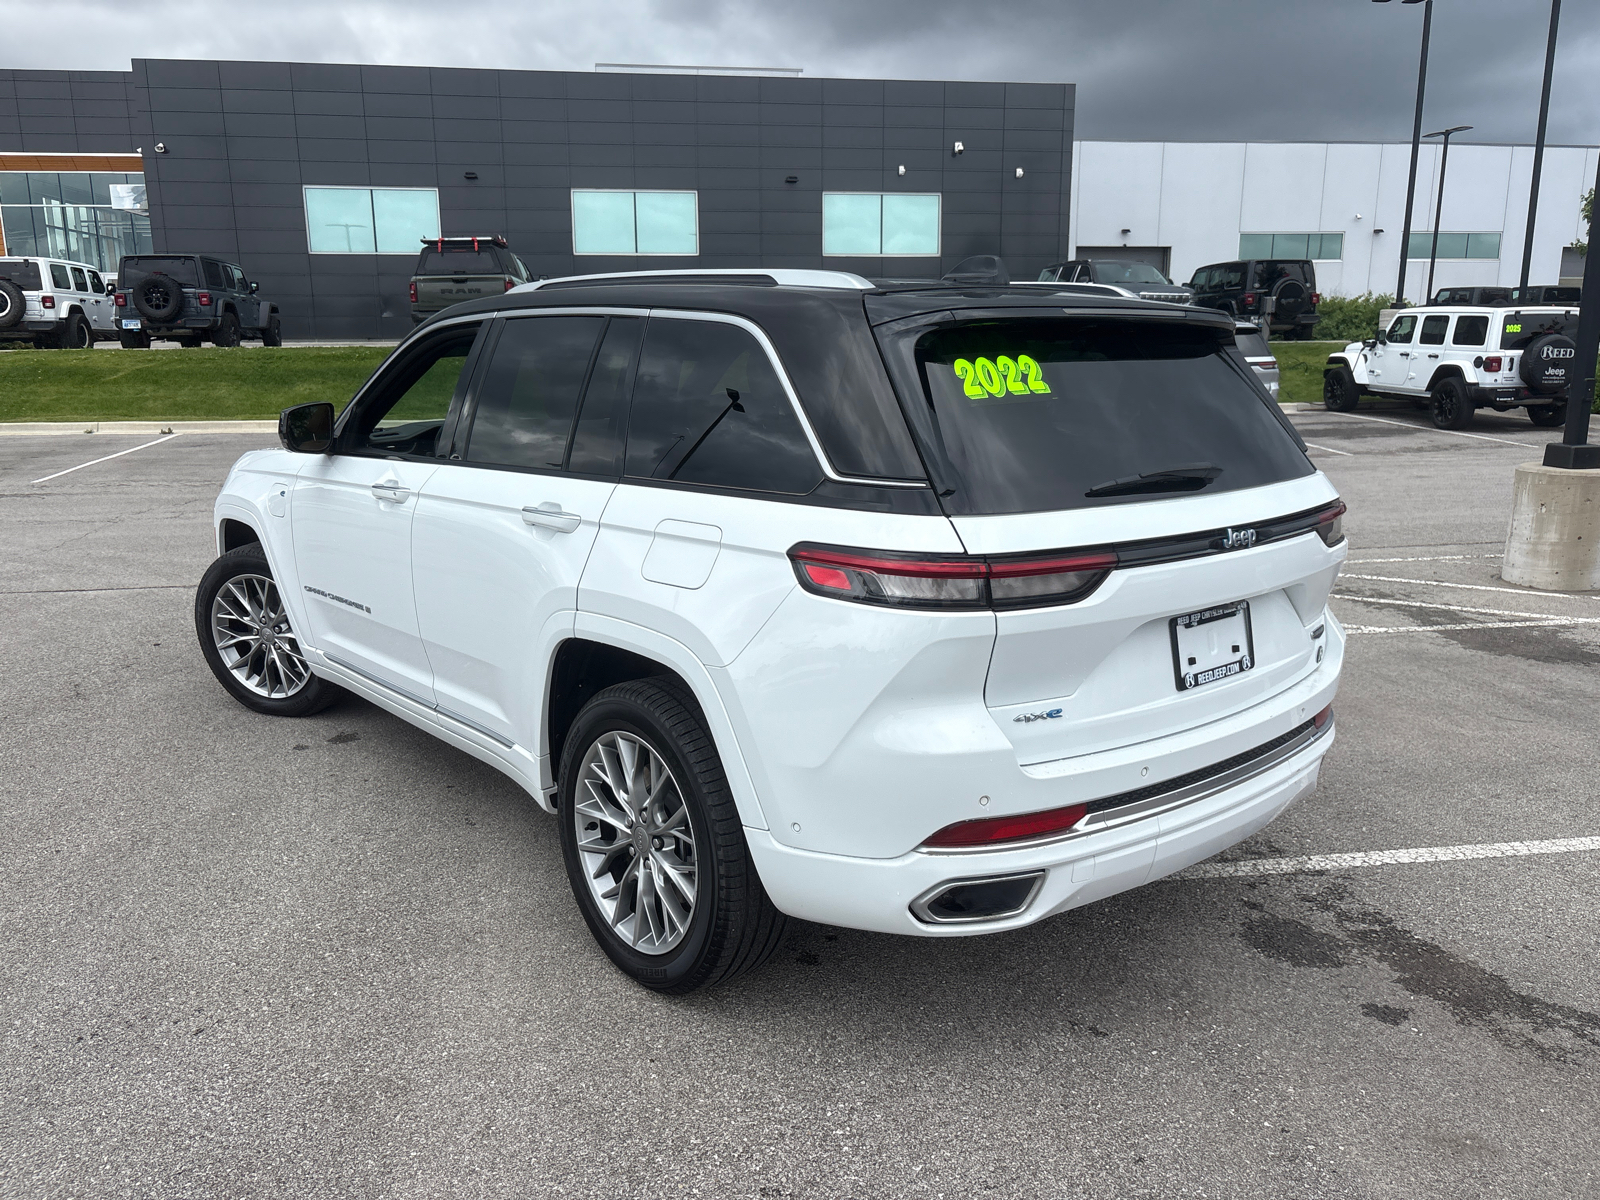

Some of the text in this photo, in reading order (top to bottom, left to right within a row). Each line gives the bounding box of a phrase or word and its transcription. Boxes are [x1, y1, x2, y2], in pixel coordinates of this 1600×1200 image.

[1505, 324, 1522, 333] 2025
[1541, 344, 1575, 361] REED
[953, 354, 1052, 400] 2022
[1545, 366, 1566, 377] Jeep
[1222, 528, 1257, 549] Jeep
[1177, 615, 1190, 626] REED
[1190, 612, 1202, 622] JEEP
[1197, 662, 1241, 685] REEDJEEP.COM
